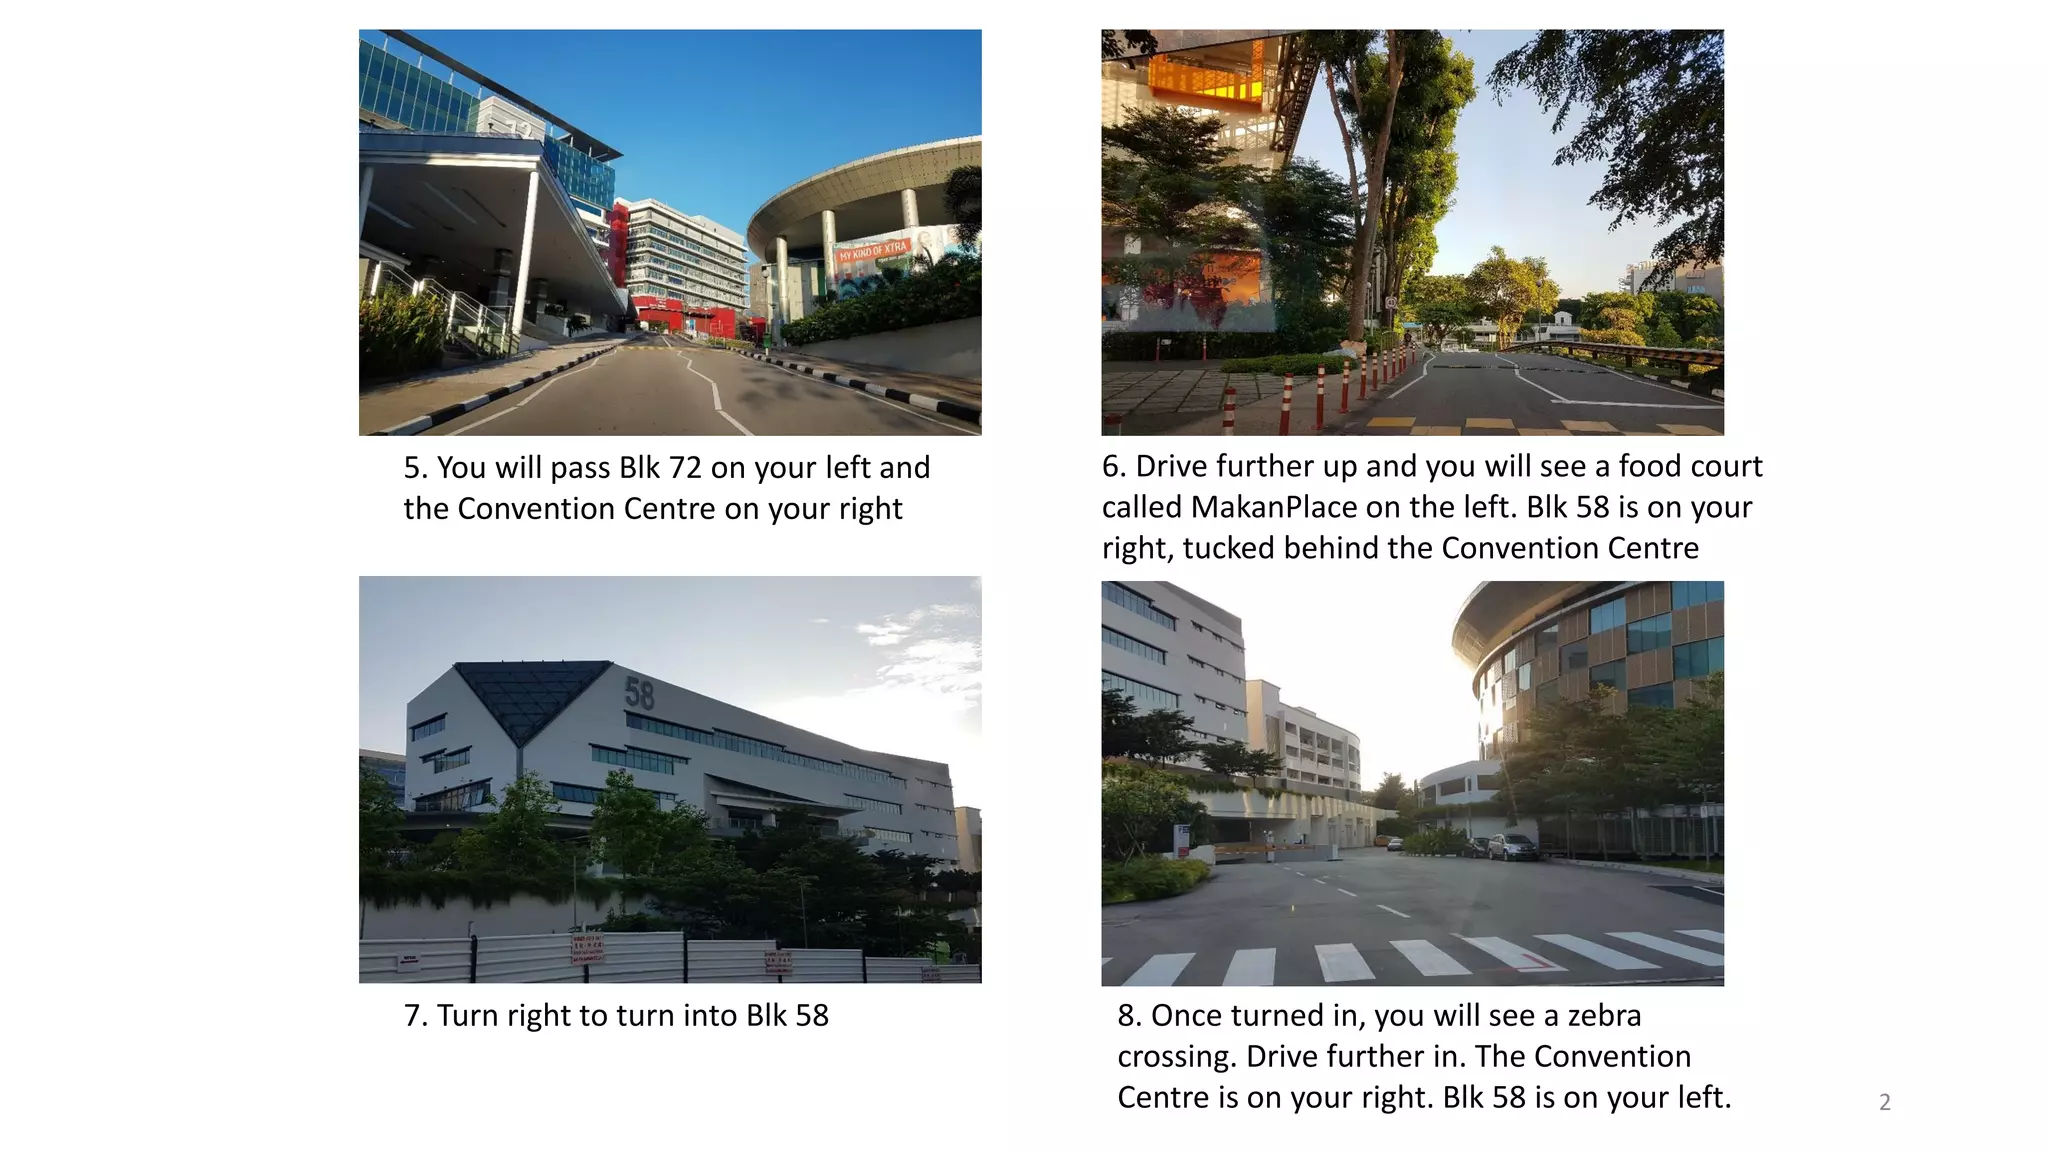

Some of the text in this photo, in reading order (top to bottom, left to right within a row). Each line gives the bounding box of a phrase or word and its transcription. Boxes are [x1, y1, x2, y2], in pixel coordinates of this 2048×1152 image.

[505, 119, 535, 140] 72
[840, 251, 852, 261] MY
[853, 247, 872, 259] KIND
[873, 245, 883, 256] OF
[884, 241, 908, 254] XTRA
[625, 675, 655, 711] 58
